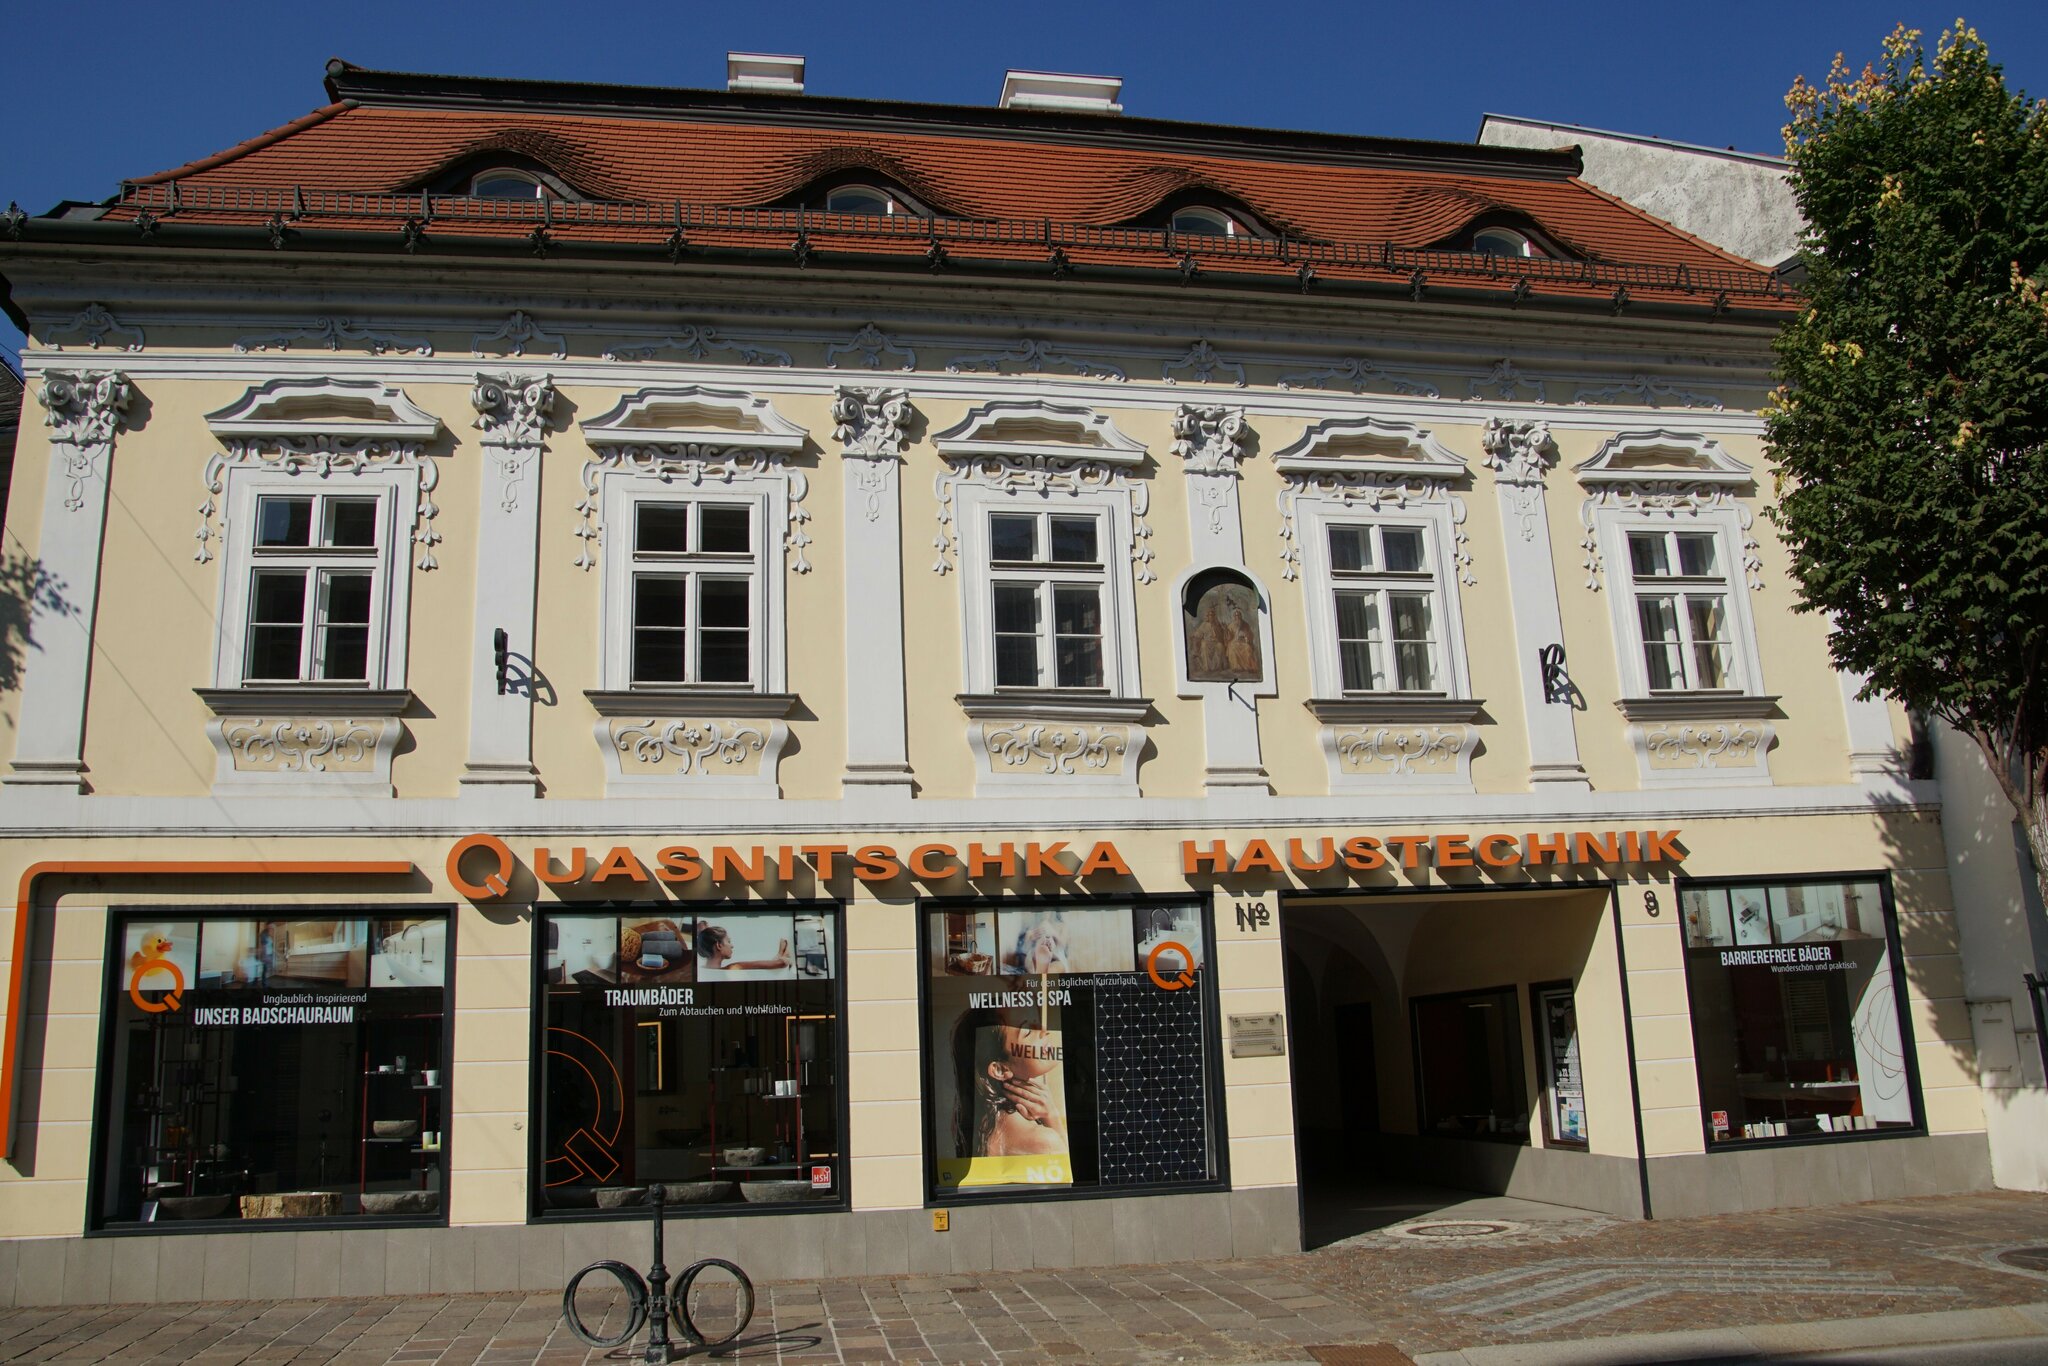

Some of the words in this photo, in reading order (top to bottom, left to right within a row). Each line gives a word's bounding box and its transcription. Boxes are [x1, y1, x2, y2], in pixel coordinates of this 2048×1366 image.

[446, 833, 1131, 900] QUASNITSCHKA
[1181, 830, 1687, 874] HAUSTECHNIK
[1721, 948, 1797, 966] BARRIEREFREIE
[1799, 945, 1832, 962] BÄDER
[1771, 963, 1814, 973] Wunderschön
[1815, 962, 1827, 971] und
[1829, 961, 1857, 972] praktisch
[1026, 979, 1039, 988] Für
[1057, 978, 1094, 989] täglichen
[1095, 976, 1137, 986] Kurzurlaub
[263, 993, 314, 1006] Unglaublich
[316, 993, 367, 1005] inspirierend
[604, 986, 694, 1006] TRAUMBÄDER
[969, 991, 1034, 1009] WELLNESS
[1048, 990, 1072, 1006] SPA
[194, 1007, 239, 1025] UNSER
[242, 1006, 353, 1025] BADSCHAURAUM
[659, 1007, 678, 1017] Zum
[679, 1006, 724, 1016] Abtauchen
[726, 1005, 743, 1015] und
[745, 1004, 792, 1015] Wohlfühlen
[814, 1173, 829, 1182] HSH
[1026, 1159, 1063, 1183] NÖ
